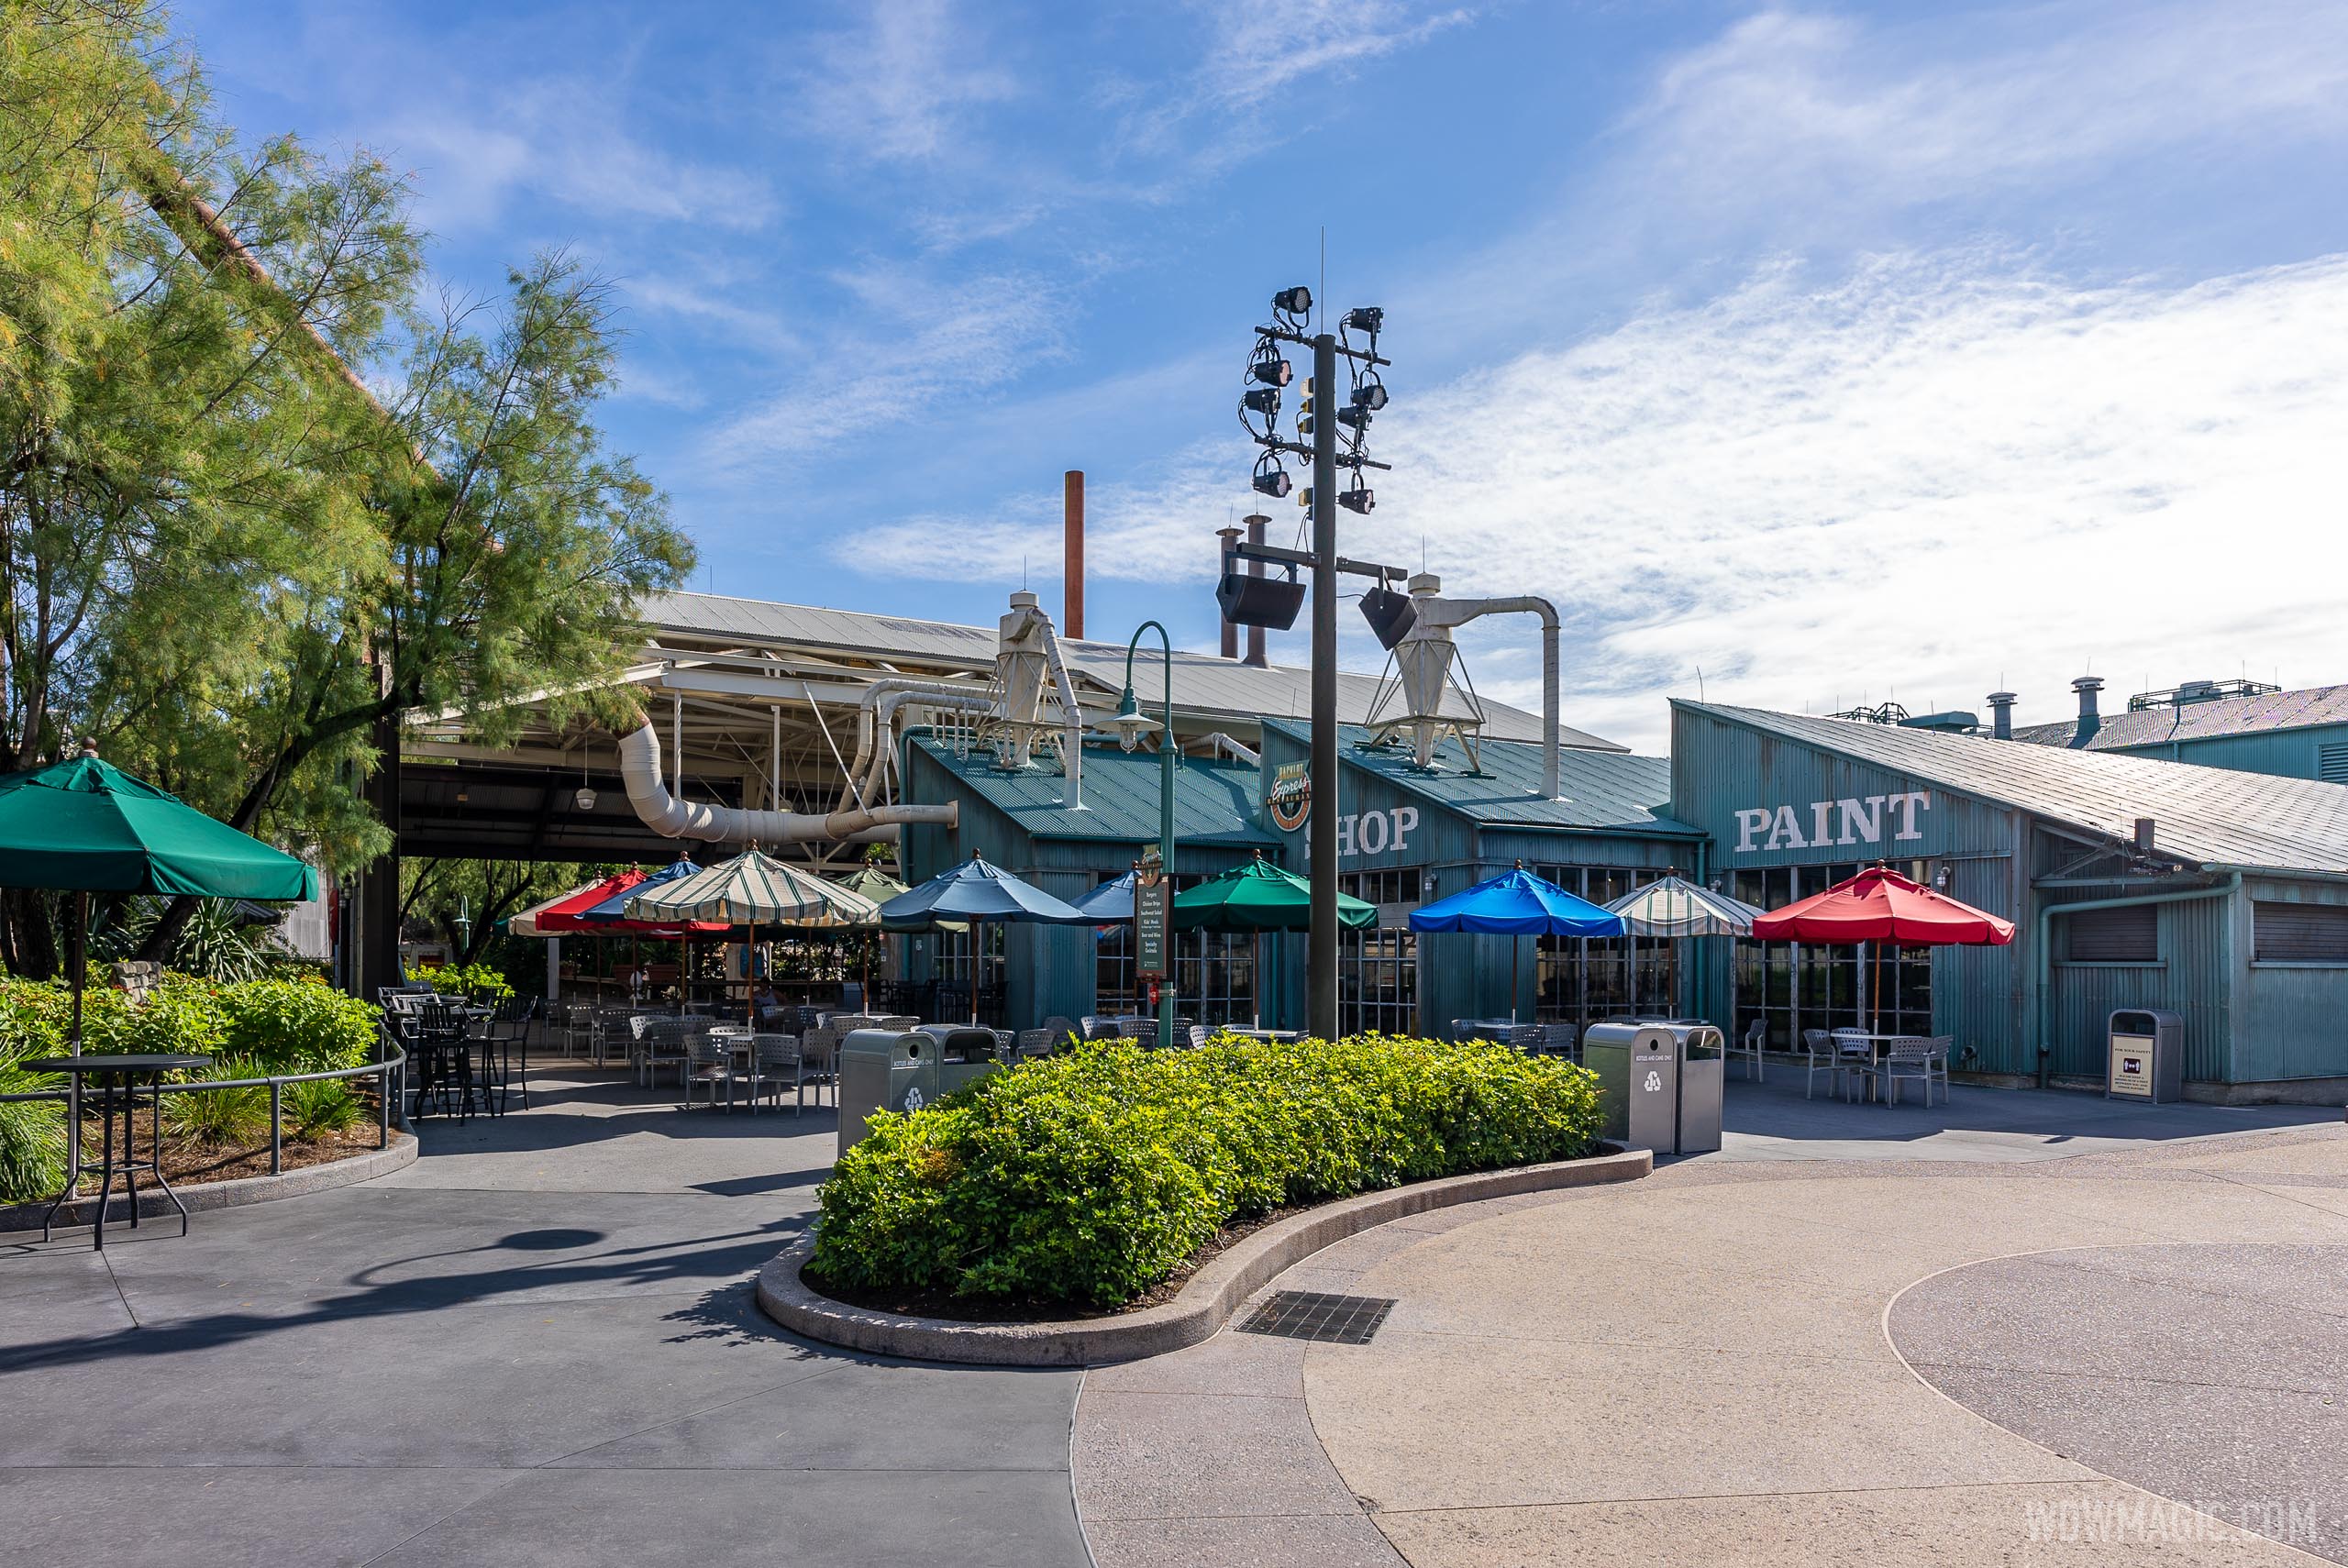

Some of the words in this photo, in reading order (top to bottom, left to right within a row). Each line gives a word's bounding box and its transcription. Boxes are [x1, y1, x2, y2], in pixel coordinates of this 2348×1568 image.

[1279, 763, 1303, 779] BACKLOT
[1267, 793, 1311, 804] RESAURAN
[1272, 777, 1311, 802] Express
[1304, 807, 1419, 859] HOP
[1734, 791, 1931, 853] PAINT
